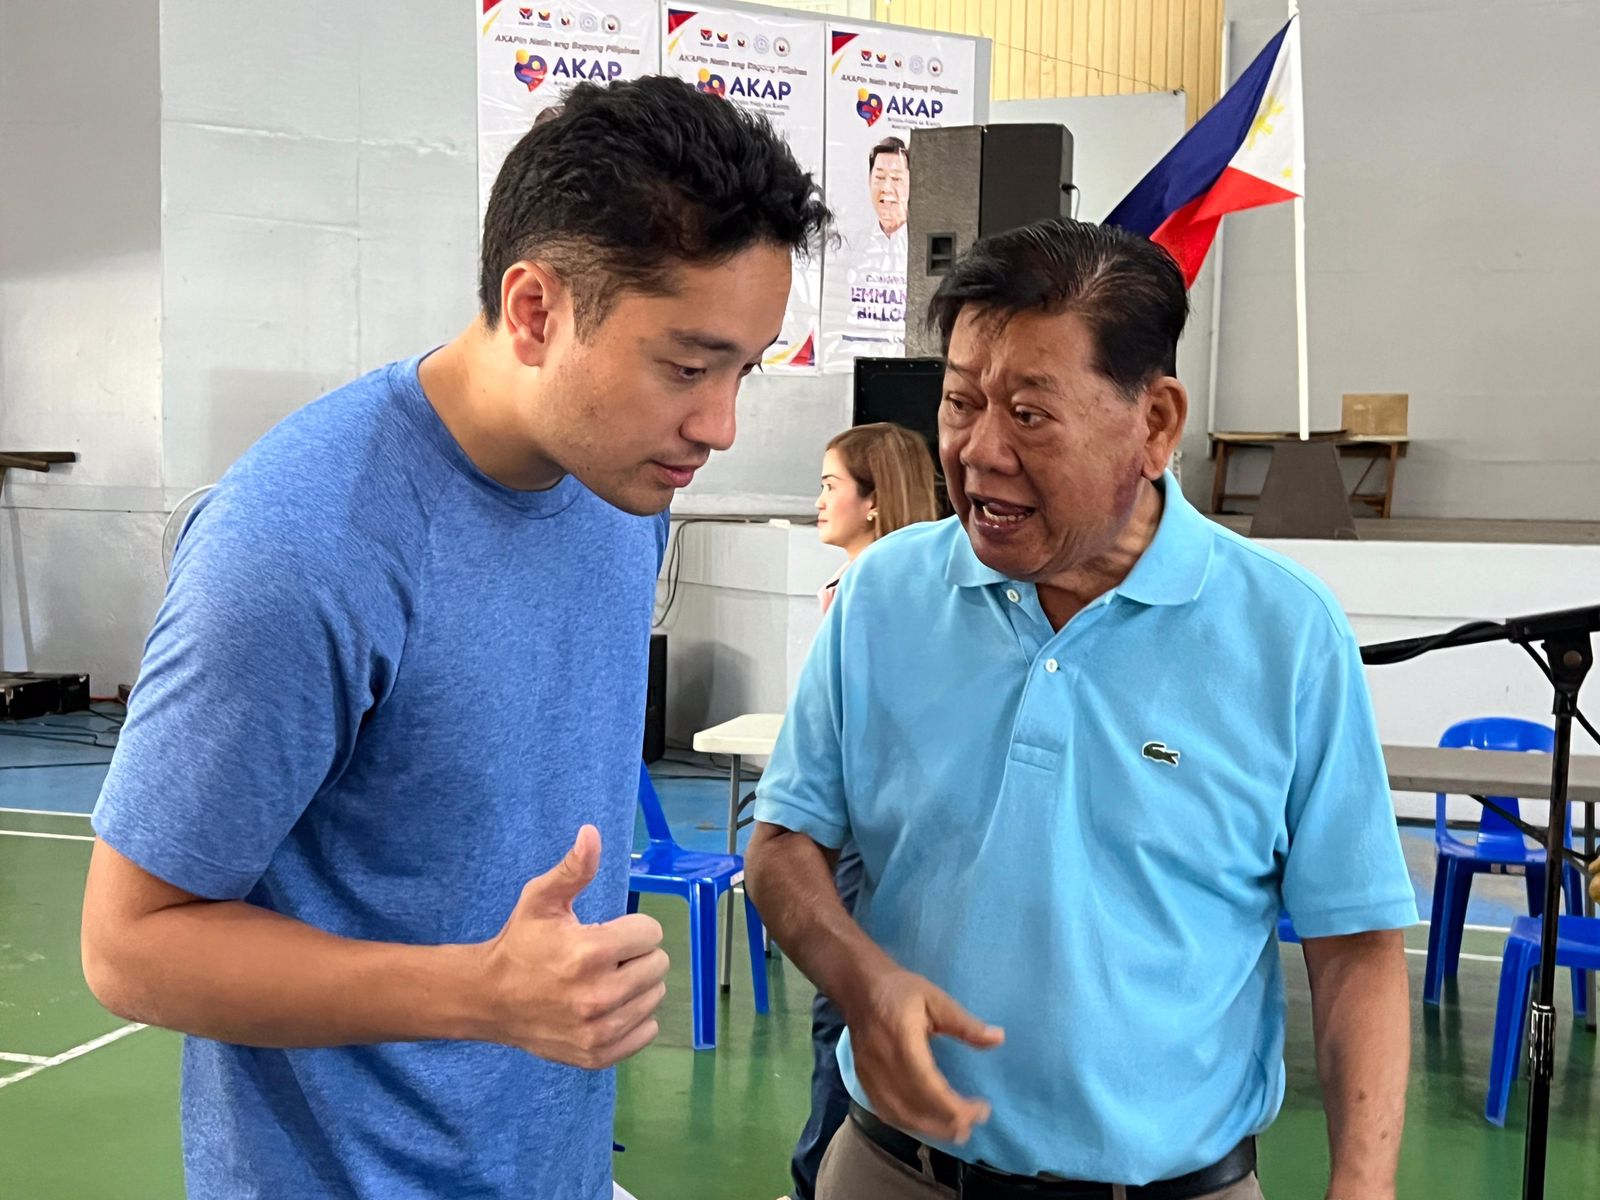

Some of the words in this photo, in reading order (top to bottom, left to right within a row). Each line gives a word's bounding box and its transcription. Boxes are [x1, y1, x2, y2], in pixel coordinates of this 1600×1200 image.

[554, 41, 570, 50] ang
[572, 42, 604, 54] Bagong
[606, 44, 640, 55] Pilipinas
[552, 56, 622, 82] AKAP
[731, 61, 745, 70] ang
[729, 76, 792, 101] AKAP
[888, 80, 901, 90] ang
[886, 95, 944, 119] AKAP
[857, 306, 905, 322] BILLO
